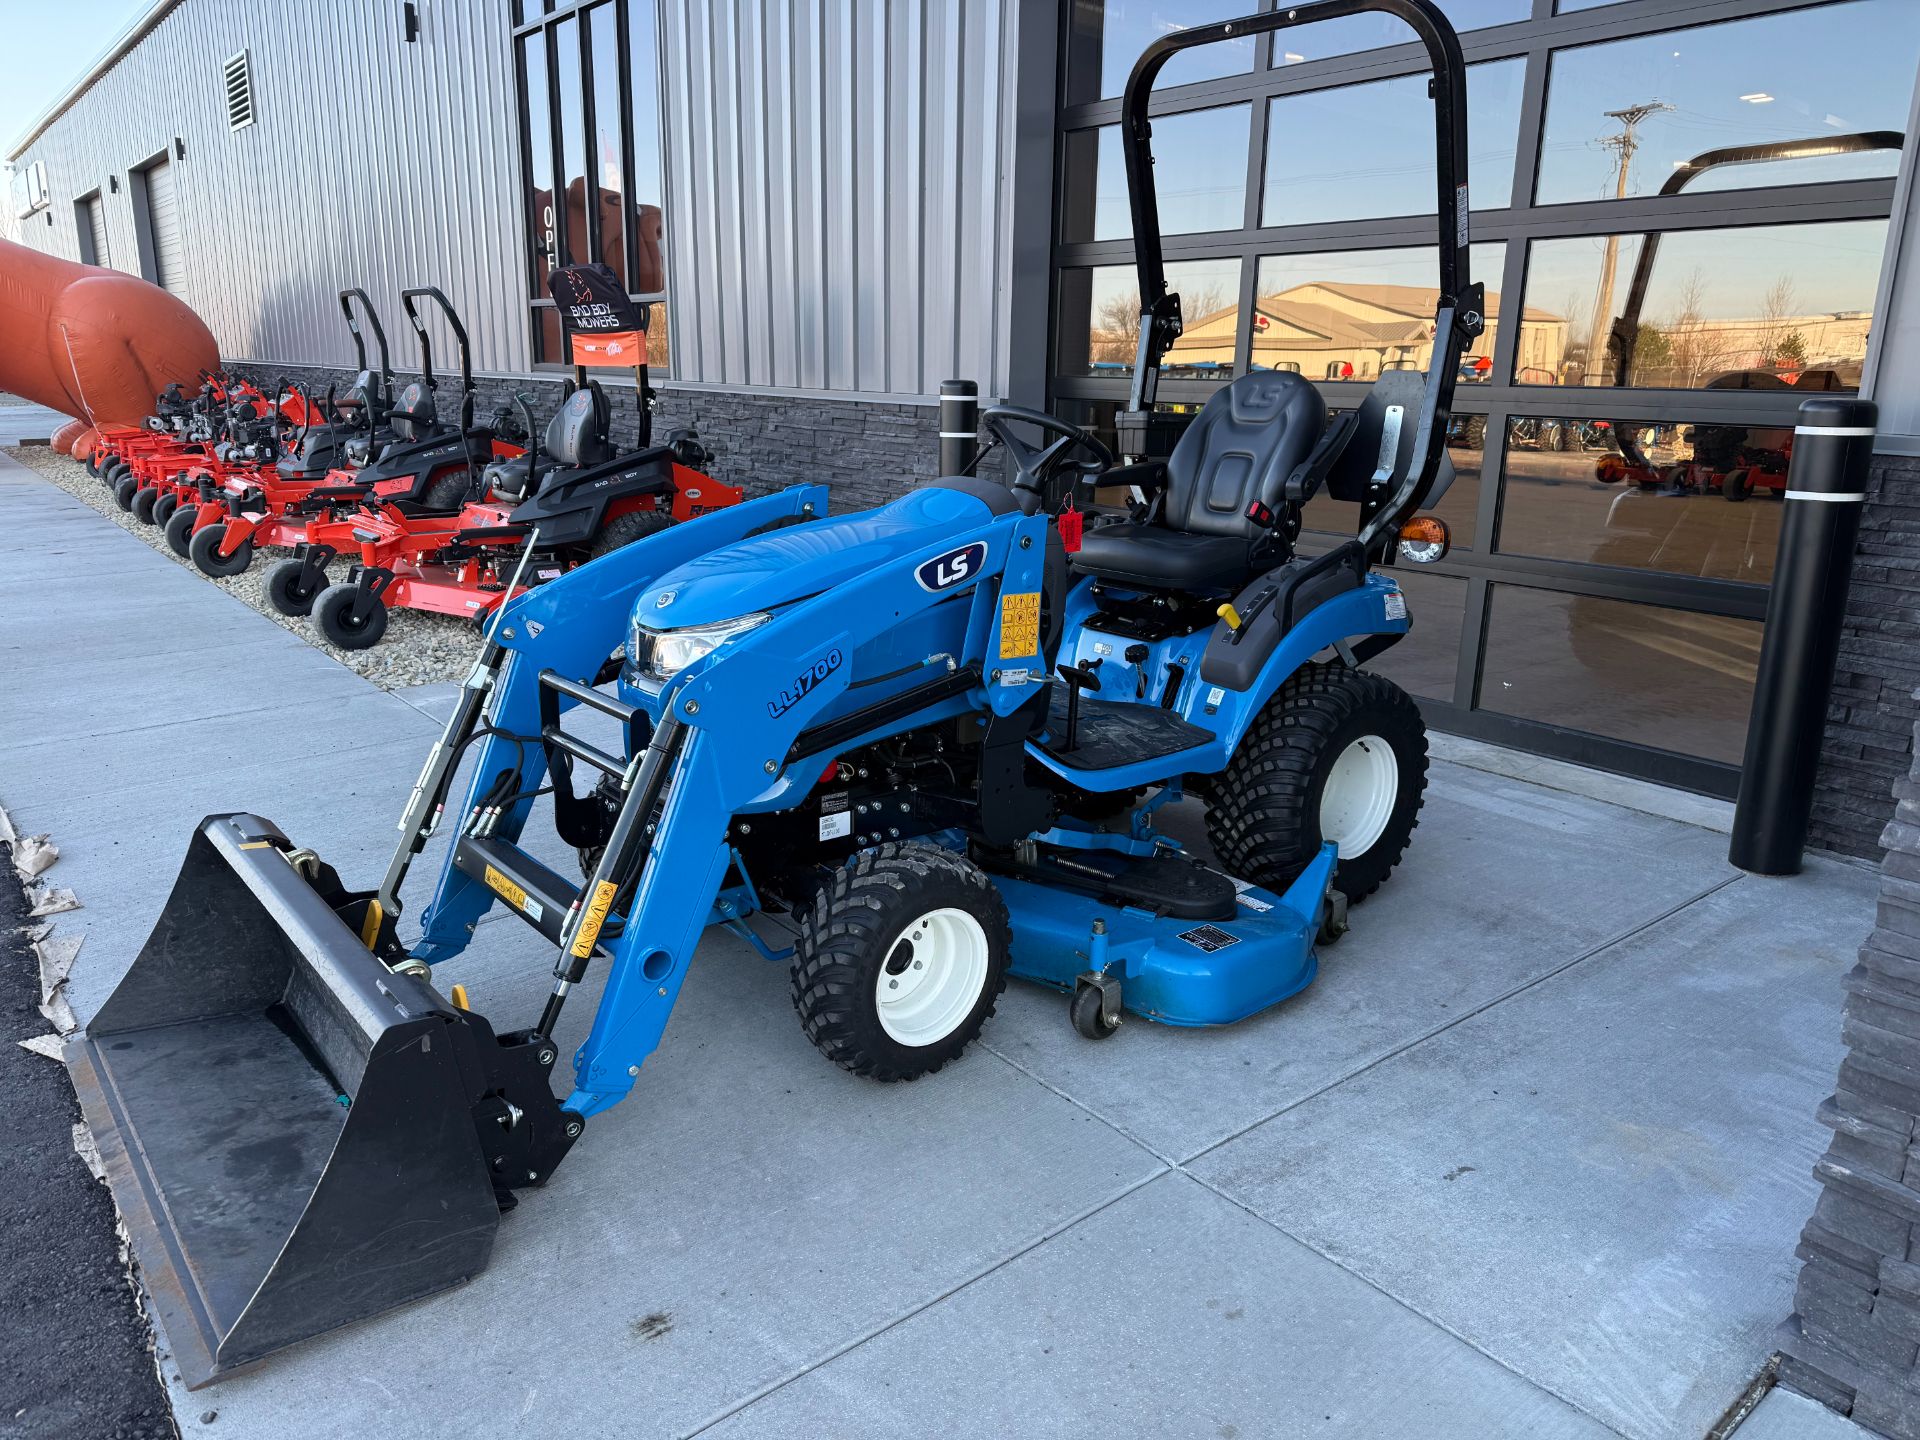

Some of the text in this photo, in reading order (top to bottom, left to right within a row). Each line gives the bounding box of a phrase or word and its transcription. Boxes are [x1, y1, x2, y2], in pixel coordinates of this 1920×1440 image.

[543, 206, 556, 297] OPE
[569, 302, 611, 317] BAD BOY
[575, 314, 620, 328] MOWERS
[594, 471, 638, 488] BAD BOY
[937, 553, 968, 586] LS
